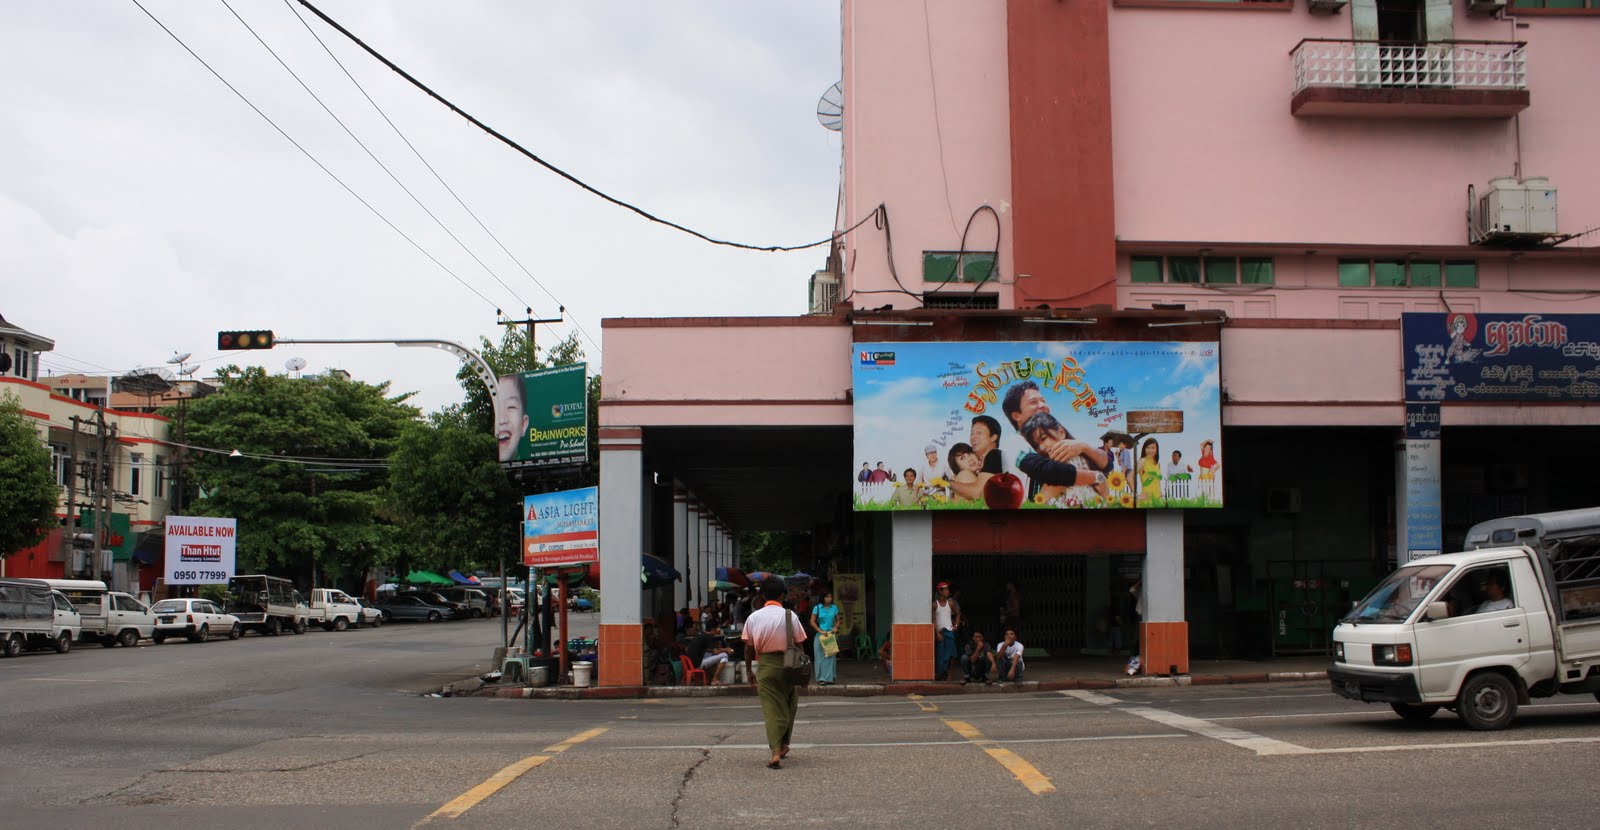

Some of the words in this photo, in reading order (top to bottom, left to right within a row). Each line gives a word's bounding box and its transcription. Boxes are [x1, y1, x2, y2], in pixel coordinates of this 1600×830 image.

[564, 403, 584, 411] TOTAL
[538, 507, 560, 520] ASIA
[564, 503, 594, 516] LIGHT
[168, 525, 214, 536] AVAILABLE
[216, 526, 234, 538] NOW
[182, 546, 202, 556] Than
[203, 546, 220, 556] Htut
[174, 571, 196, 580] 0950
[199, 571, 226, 580] 77999
